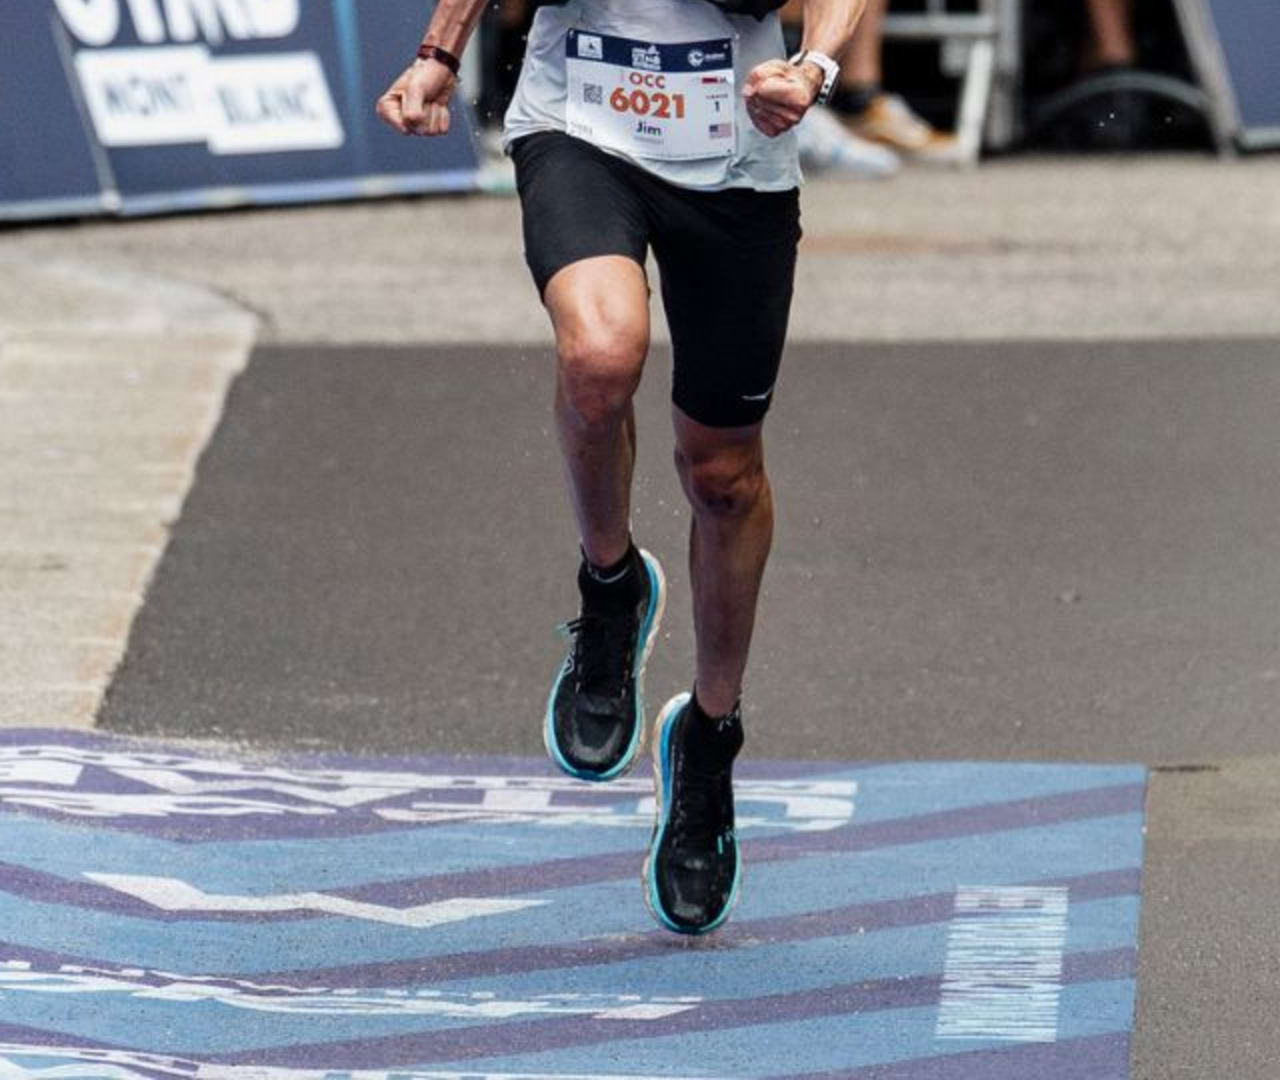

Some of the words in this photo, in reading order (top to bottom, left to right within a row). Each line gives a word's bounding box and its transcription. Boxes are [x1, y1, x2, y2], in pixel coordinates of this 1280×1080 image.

[629, 71, 666, 89] OCC
[609, 87, 685, 119] 6021
[636, 122, 662, 136] Jim
